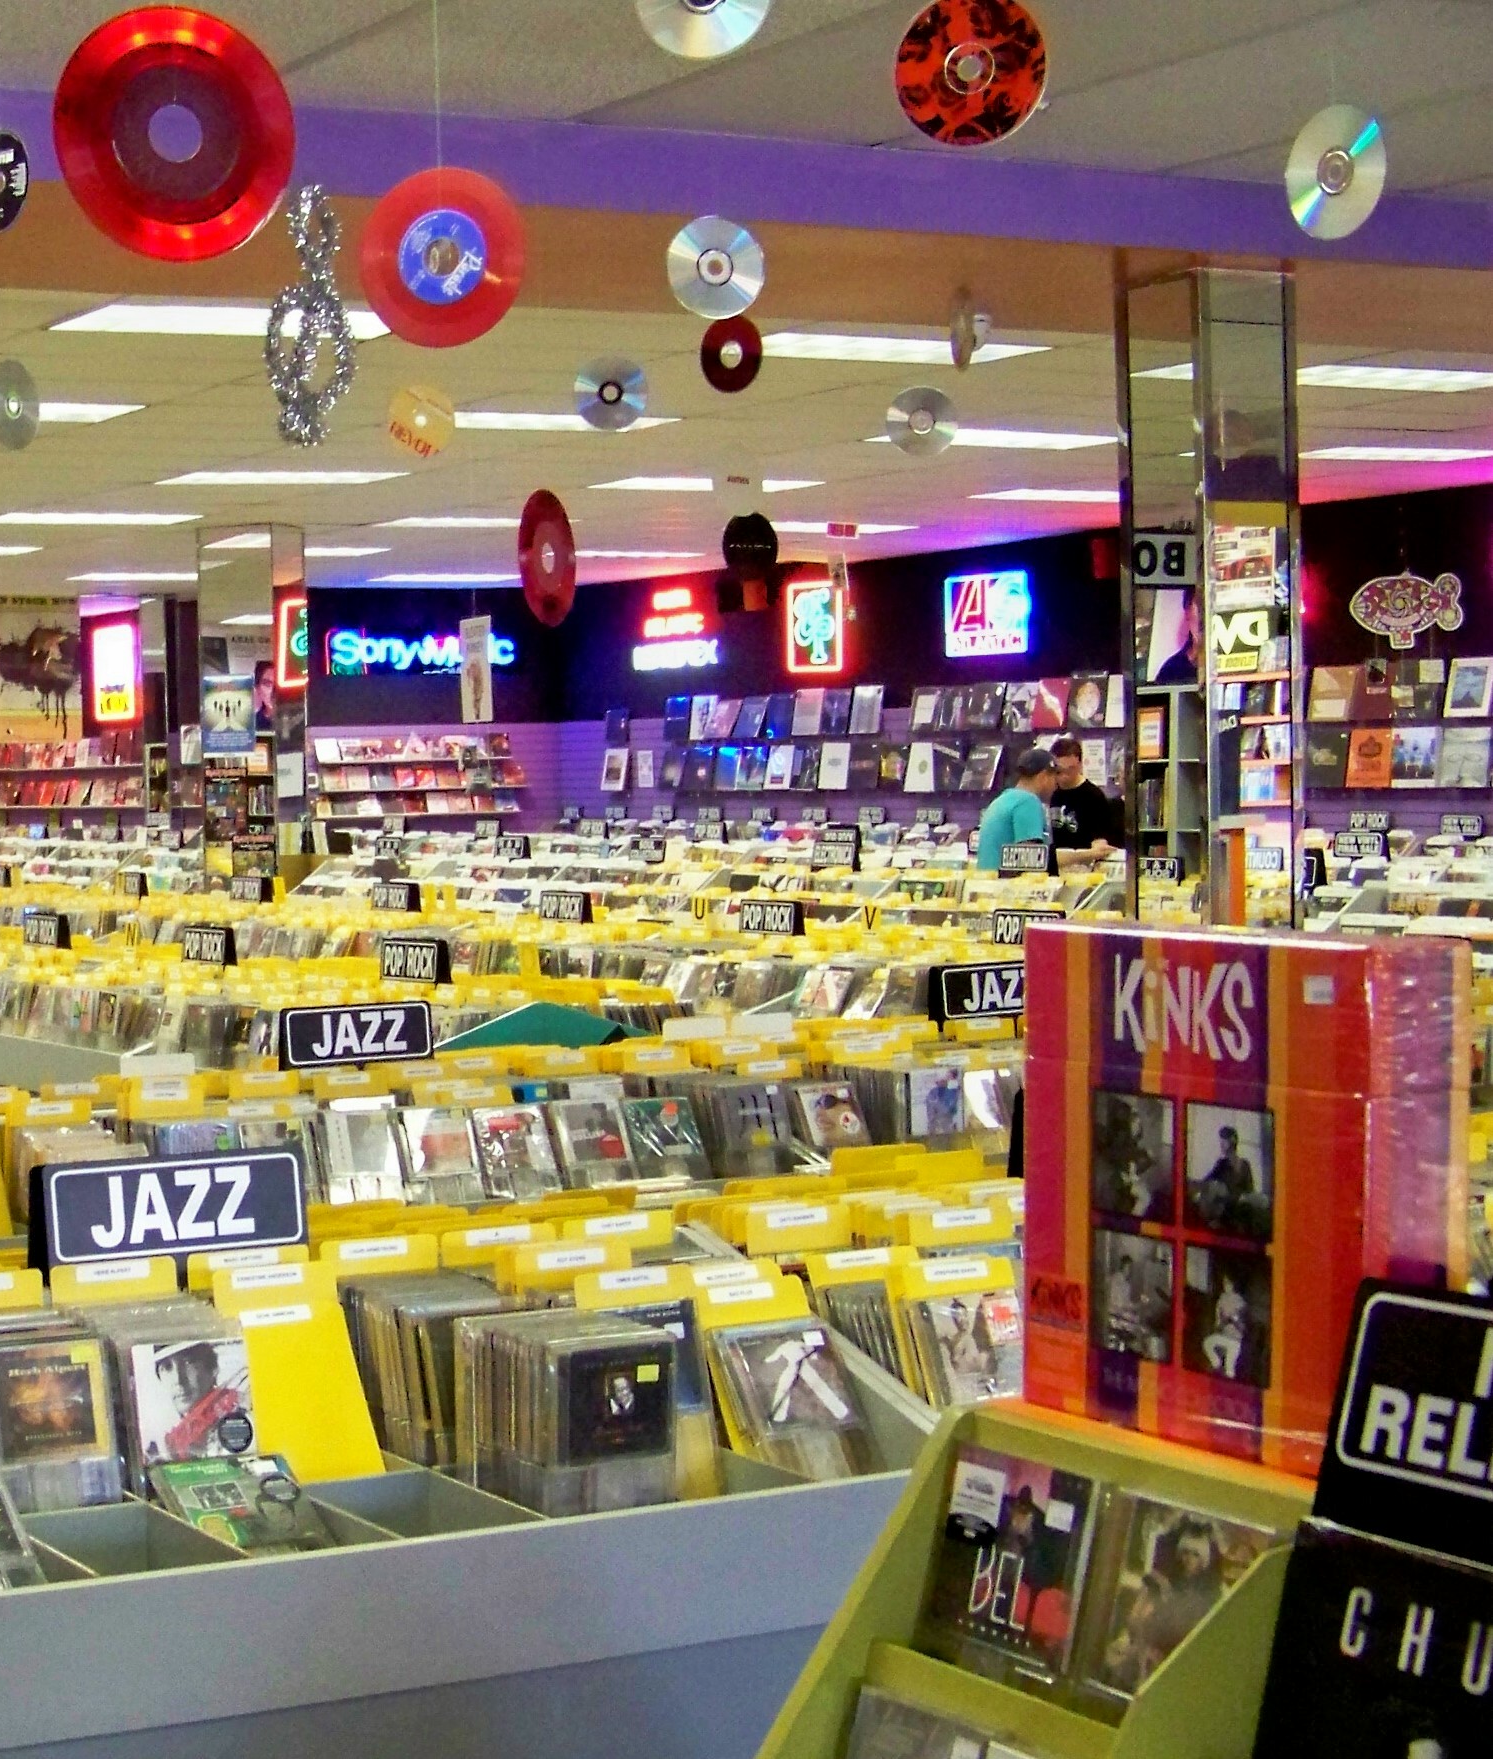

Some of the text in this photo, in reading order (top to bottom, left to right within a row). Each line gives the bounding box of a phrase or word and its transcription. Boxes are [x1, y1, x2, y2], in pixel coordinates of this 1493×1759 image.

[742, 904, 791, 931] POP/ROCK
[384, 944, 435, 979] POP/ROCK
[963, 966, 1024, 1013] JAZ
[312, 1009, 408, 1059] JAZZ
[91, 1165, 256, 1249] JAZZ
[1359, 1383, 1493, 1482] REL
